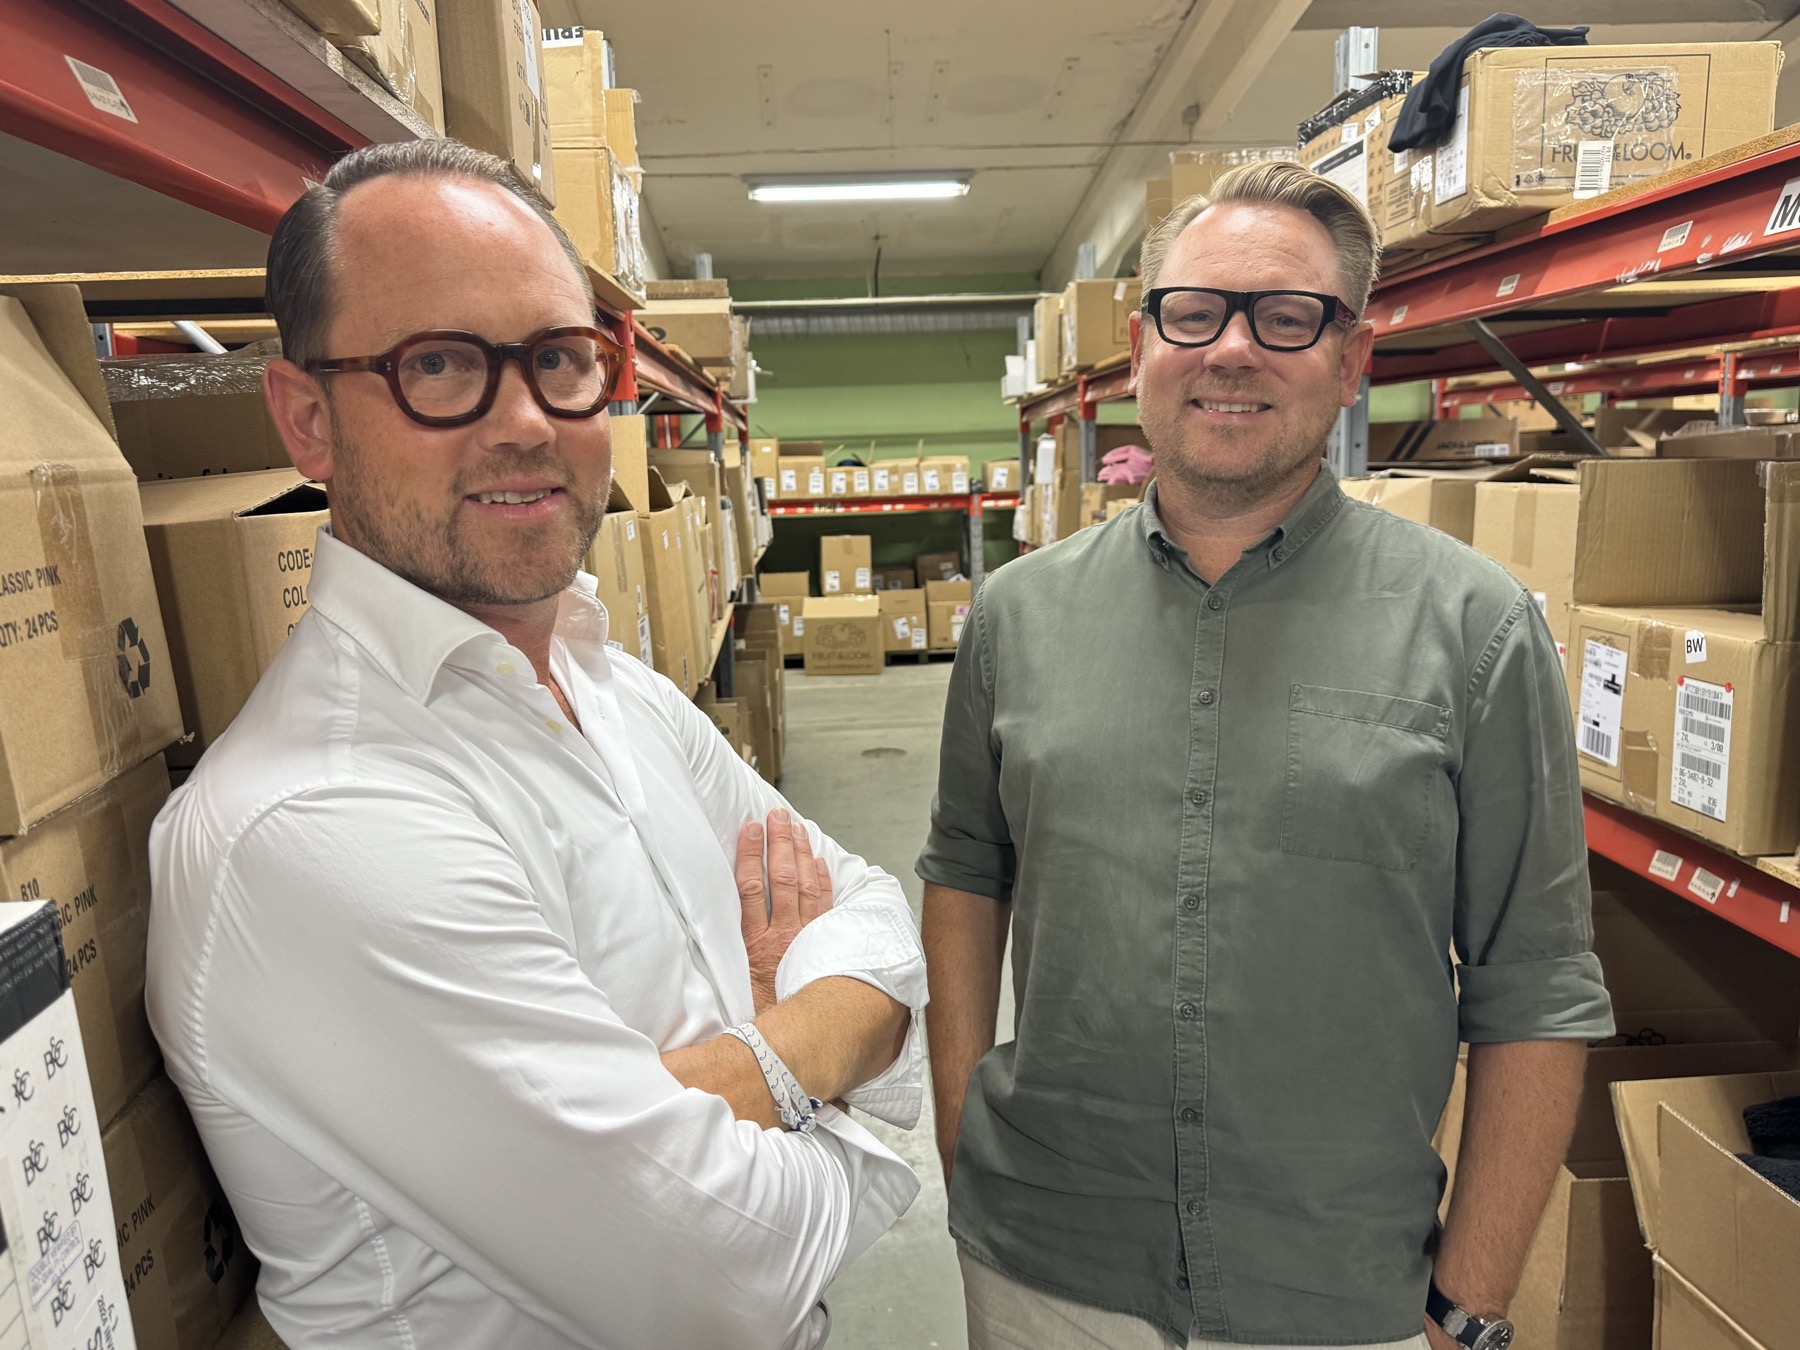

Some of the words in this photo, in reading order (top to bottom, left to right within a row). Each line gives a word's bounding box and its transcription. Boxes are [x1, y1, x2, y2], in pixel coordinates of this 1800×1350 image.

[36, 564, 61, 589] PINK
[283, 585, 307, 609] COL
[1686, 637, 1704, 654] BW
[74, 884, 98, 917] PINK
[132, 1192, 156, 1232] PINK
